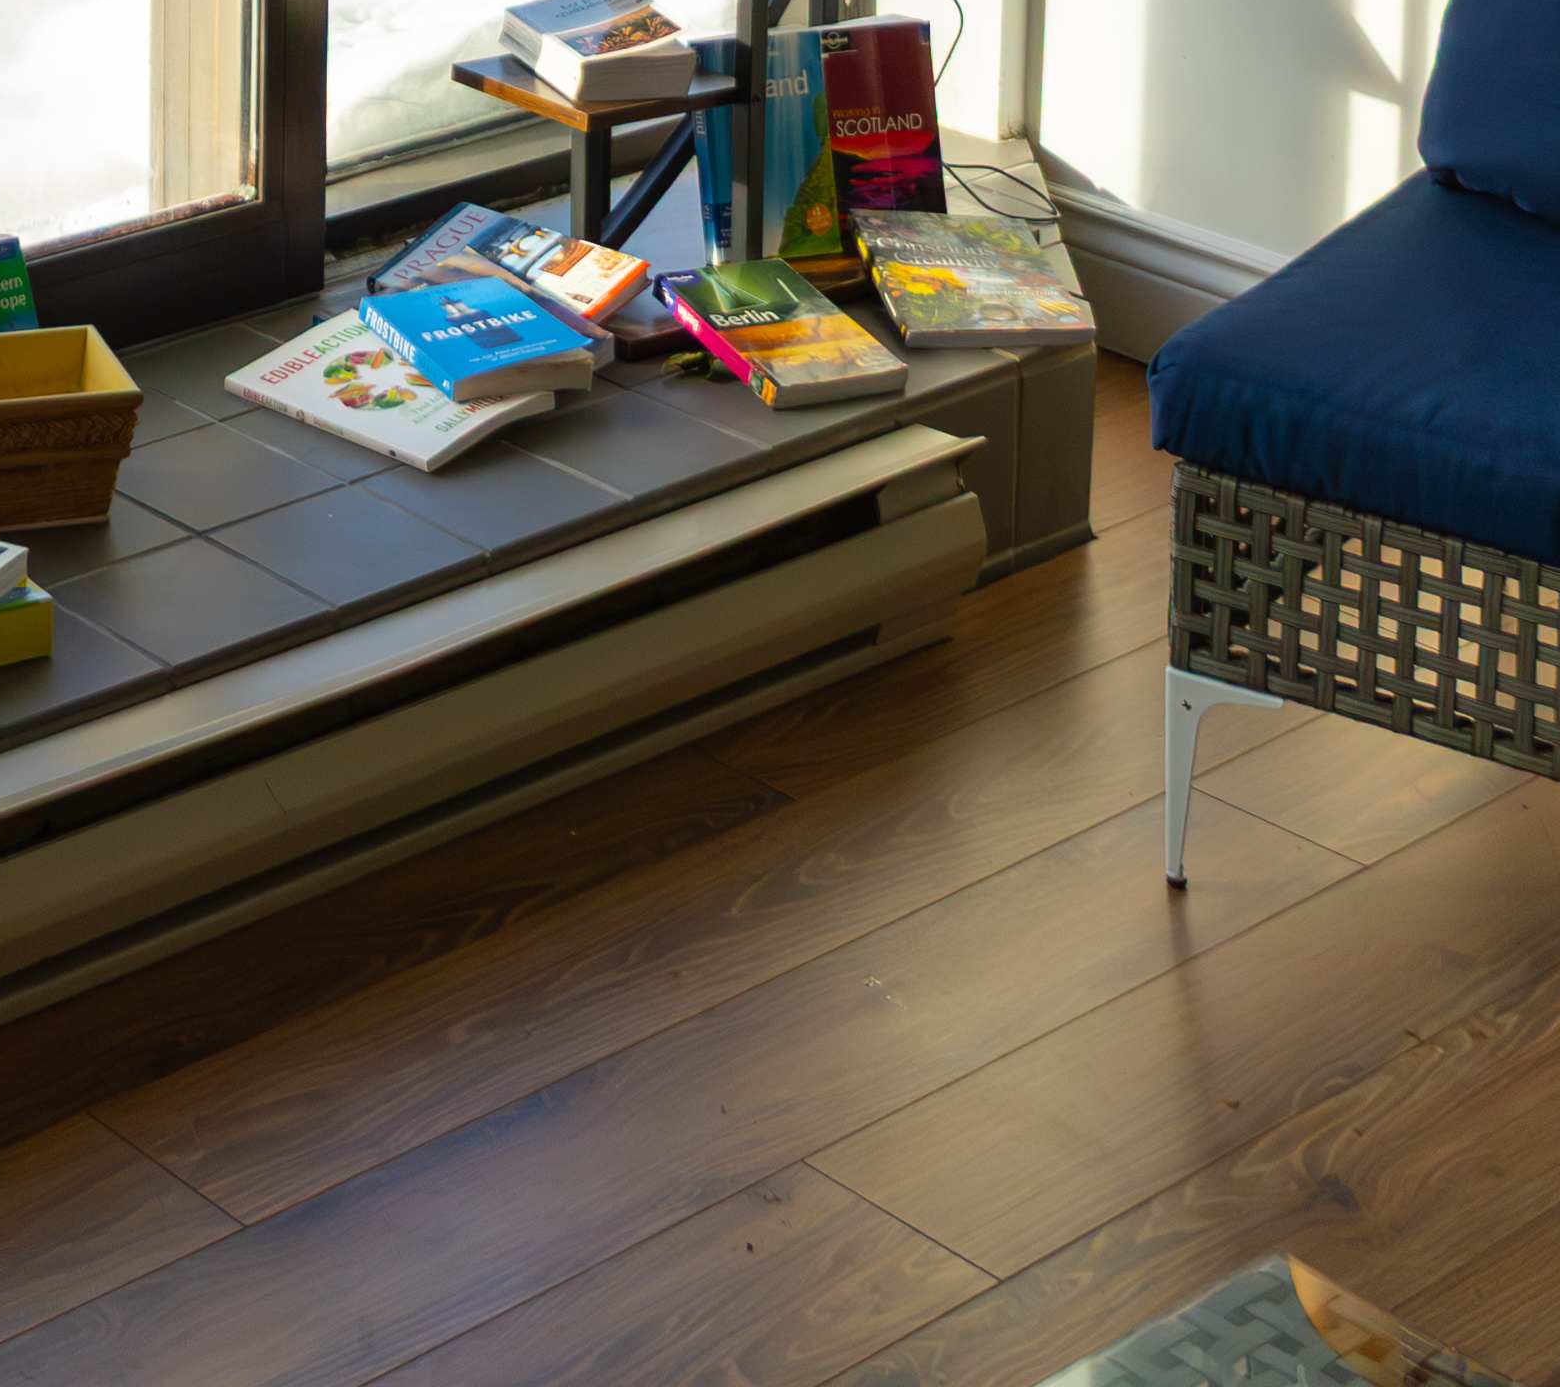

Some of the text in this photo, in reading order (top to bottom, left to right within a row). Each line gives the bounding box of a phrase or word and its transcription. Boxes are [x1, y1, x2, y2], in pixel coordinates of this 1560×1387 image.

[836, 113, 922, 138] SCOTLAND
[394, 211, 488, 280] PRAGUE
[421, 310, 538, 343] FROSTBIKE
[709, 309, 780, 327] Berlin
[364, 305, 418, 365] FROSTBIKE
